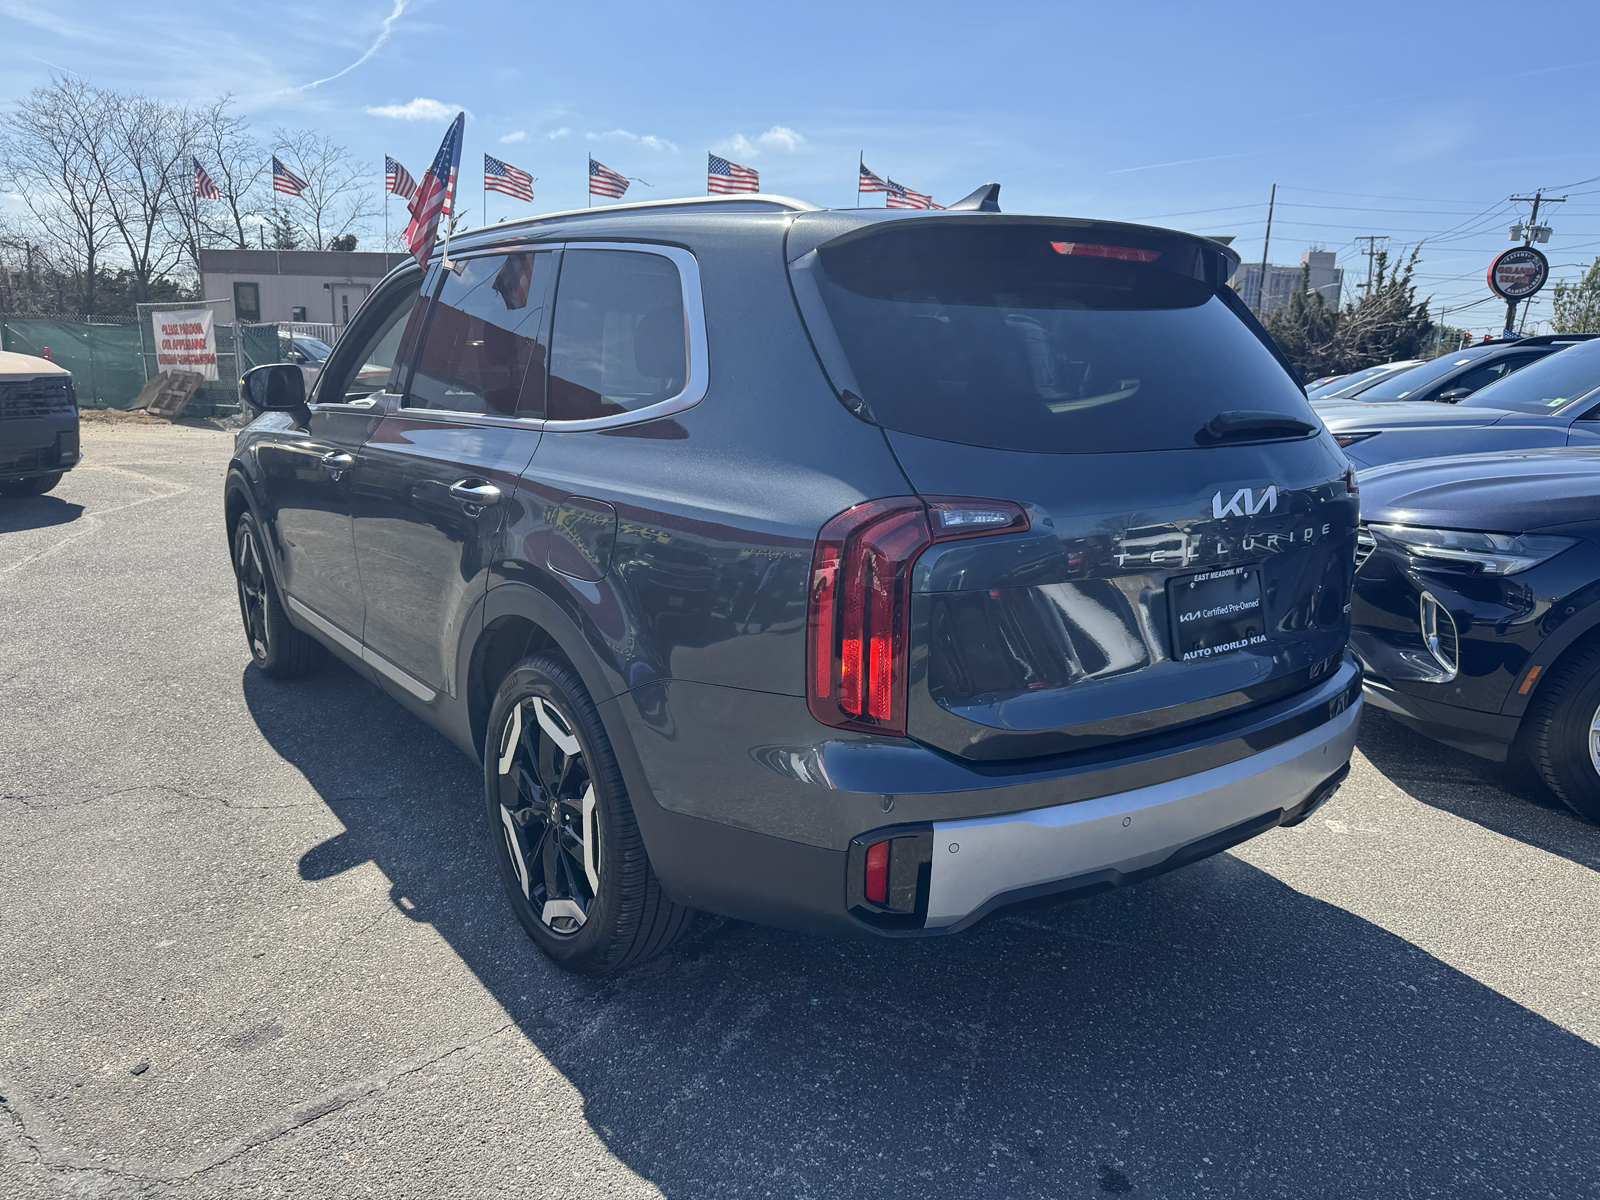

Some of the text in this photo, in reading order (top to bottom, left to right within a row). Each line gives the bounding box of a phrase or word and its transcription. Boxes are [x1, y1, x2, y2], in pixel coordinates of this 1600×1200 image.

[162, 322, 204, 336] PLEASE PARDON
[173, 338, 207, 350] APPEARANCE
[1212, 485, 1278, 519] KIA
[1113, 523, 1330, 567] TELLURIDE
[1194, 573, 1210, 582] EAST
[1235, 567, 1244, 575] NY
[1203, 605, 1228, 618] Certified
[1229, 599, 1259, 613] Pre-Owned
[1183, 634, 1267, 661] AUTO WORLD KIA
